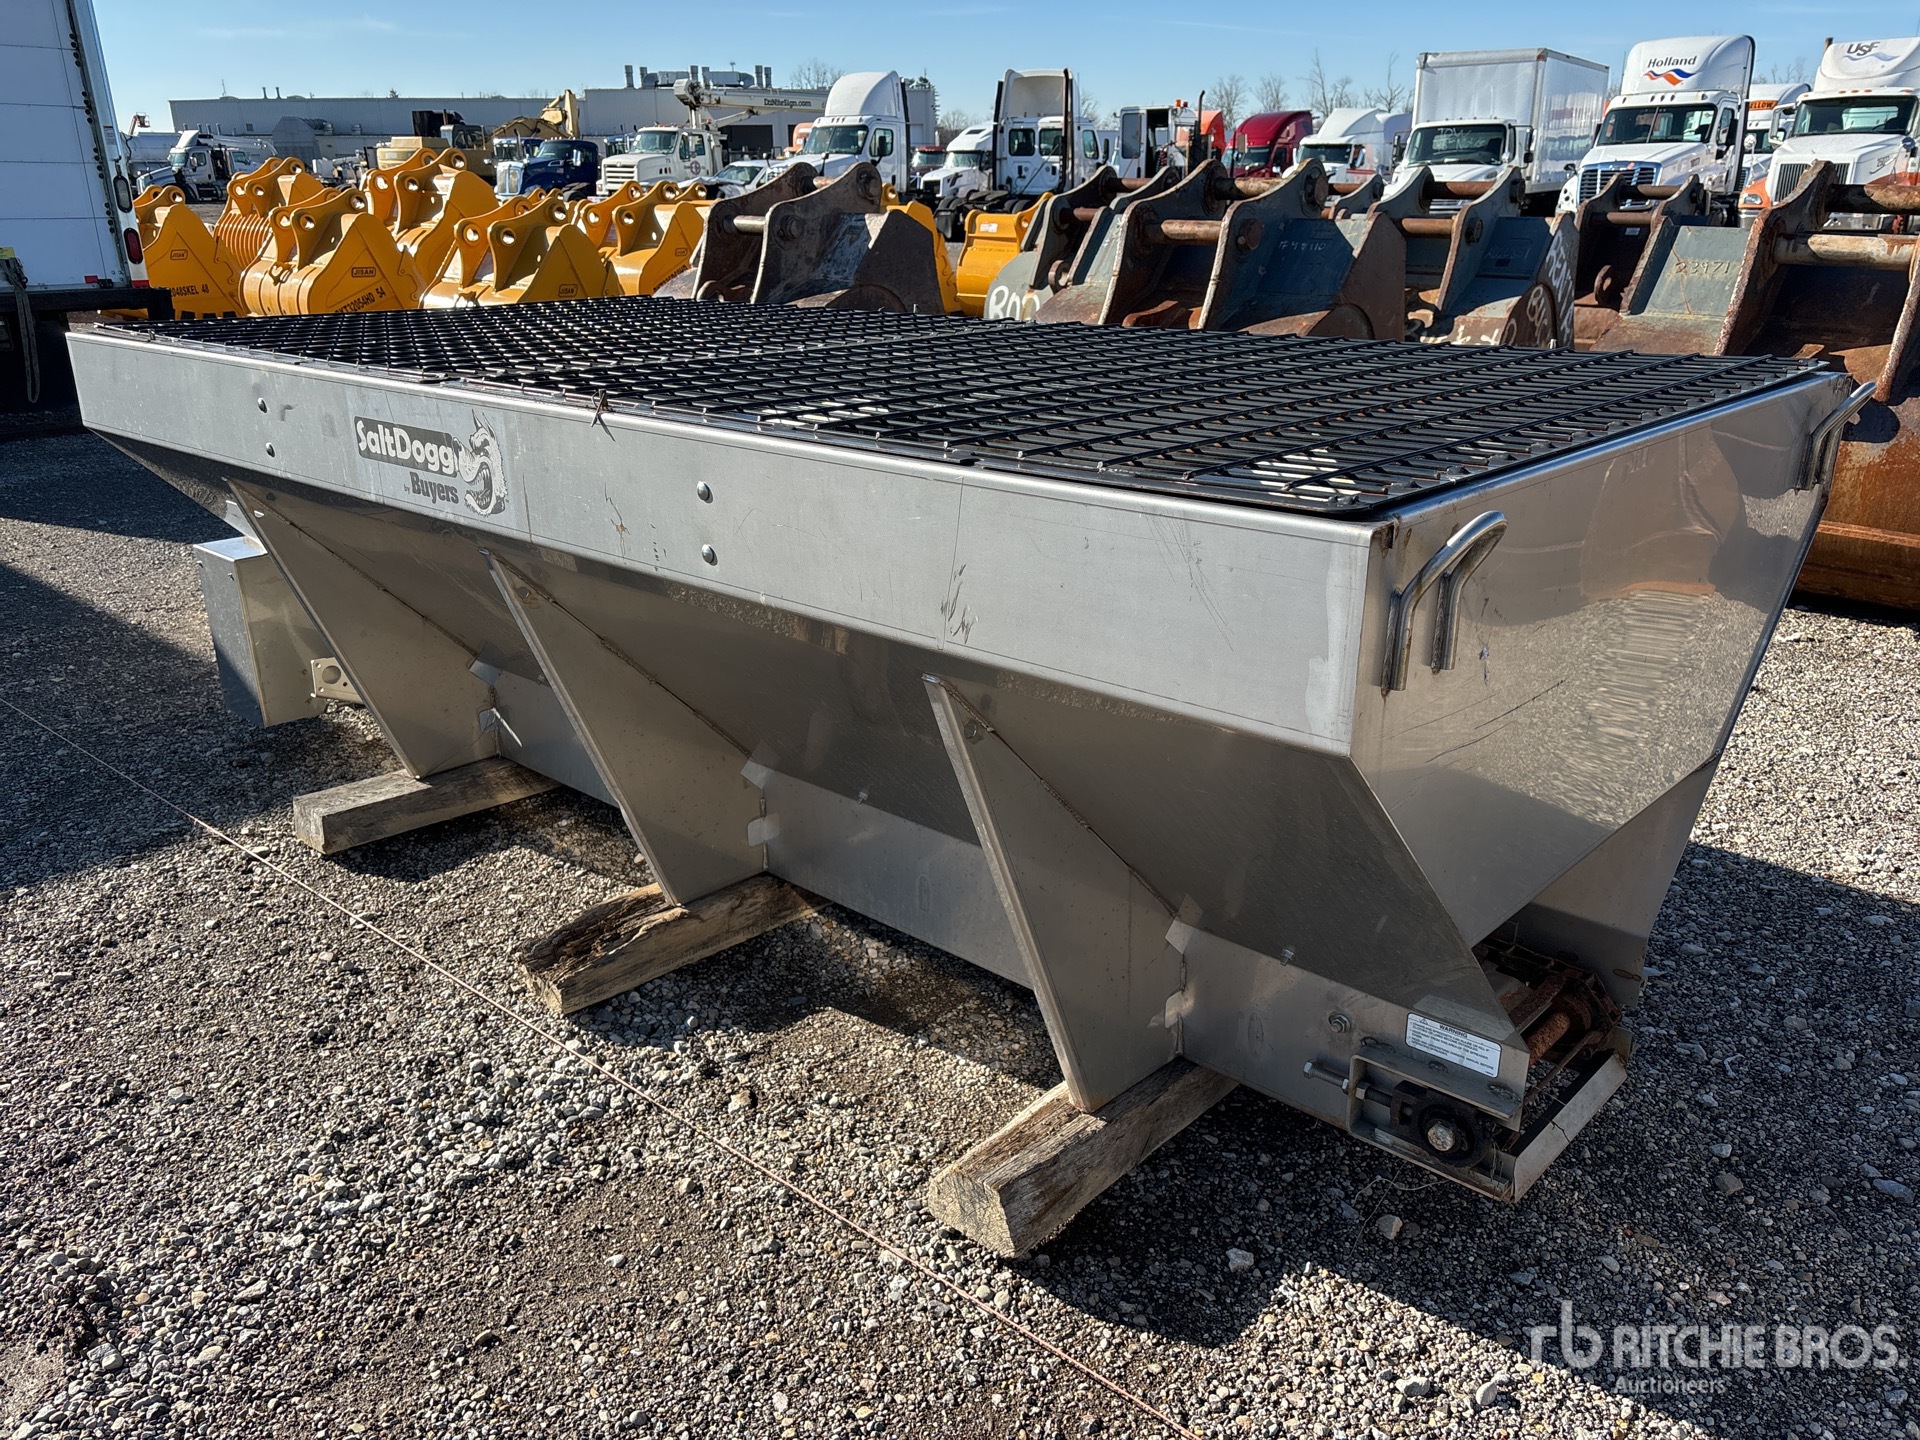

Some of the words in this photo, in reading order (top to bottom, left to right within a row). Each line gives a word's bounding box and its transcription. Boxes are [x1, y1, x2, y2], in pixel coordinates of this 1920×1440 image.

[1846, 42, 1880, 56] USF
[1648, 56, 1697, 68] Holland
[1676, 262, 1730, 274] 23971
[202, 284, 209, 294] 48
[376, 286, 386, 298] 54
[1546, 229, 1577, 344] RENTA
[356, 420, 455, 474] SaltDogg
[404, 484, 410, 494] by
[410, 472, 459, 504] Buyers
[1439, 1024, 1467, 1038] WARNING
